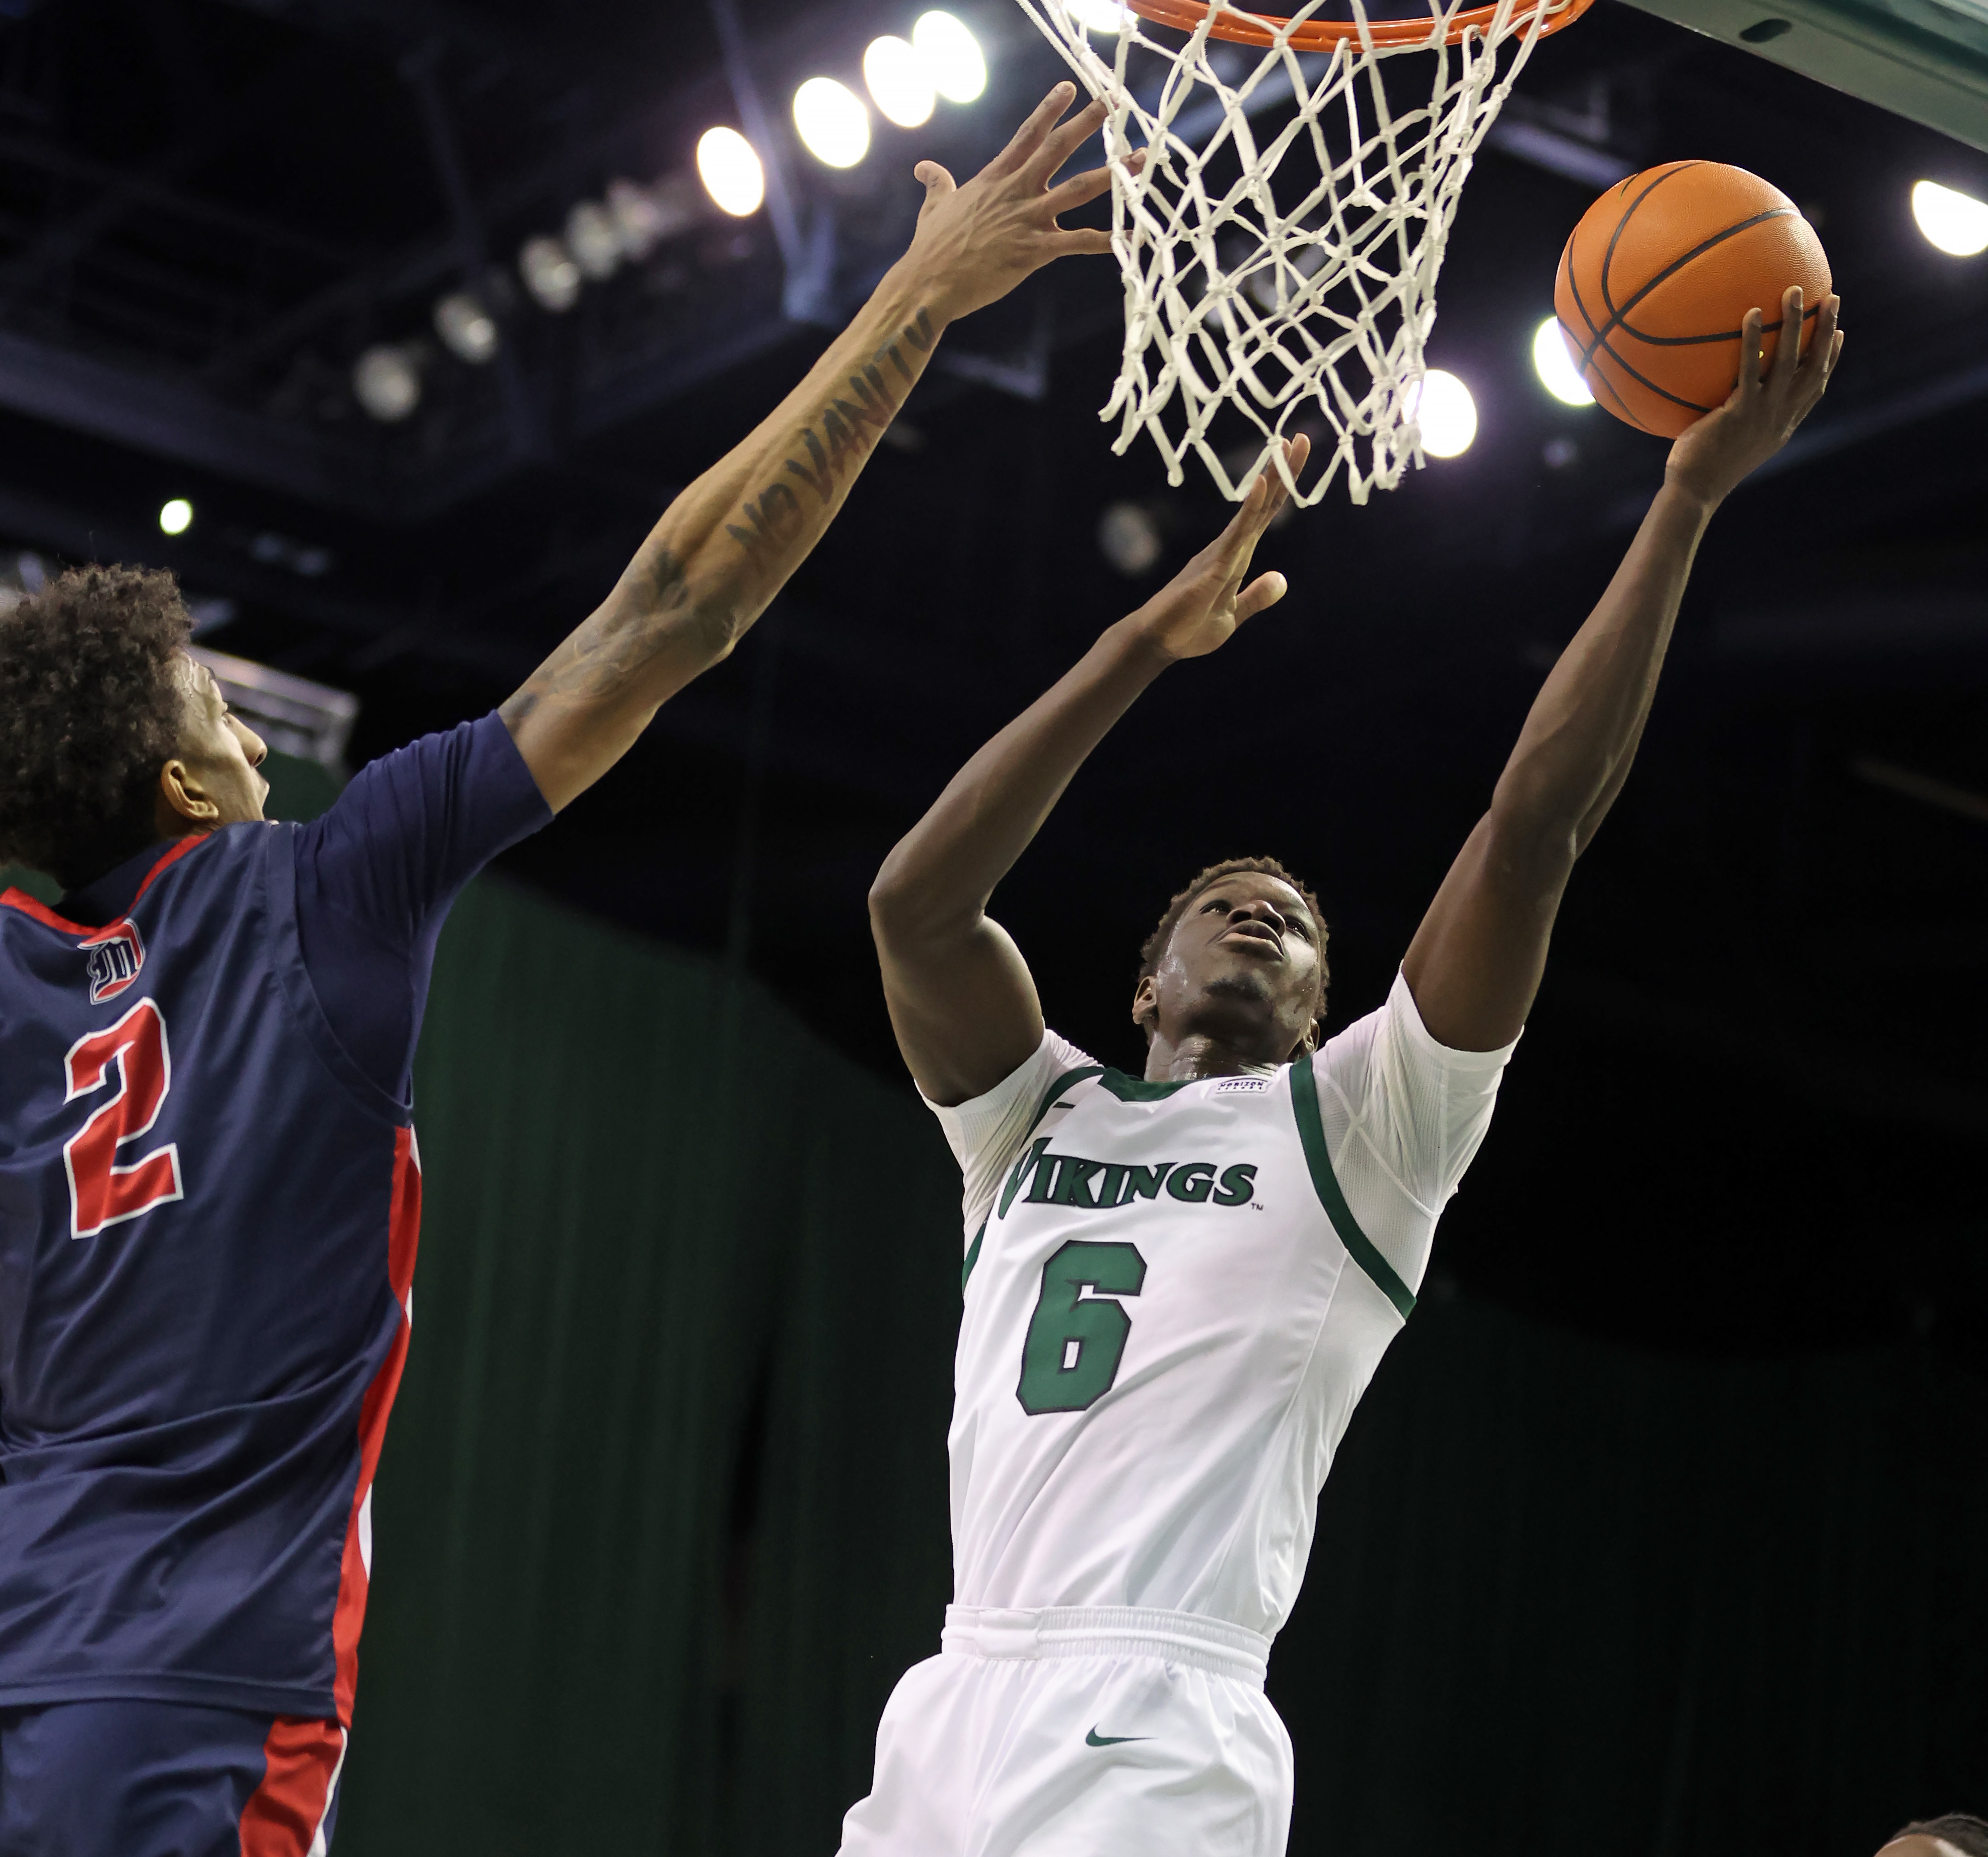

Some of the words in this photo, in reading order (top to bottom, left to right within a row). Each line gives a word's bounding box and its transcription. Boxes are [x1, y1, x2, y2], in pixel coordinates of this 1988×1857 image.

[725, 482, 803, 576] NO
[63, 996, 184, 1240] 2
[998, 1137, 1258, 1220] VIKINGS
[1016, 1240, 1147, 1415] 6
